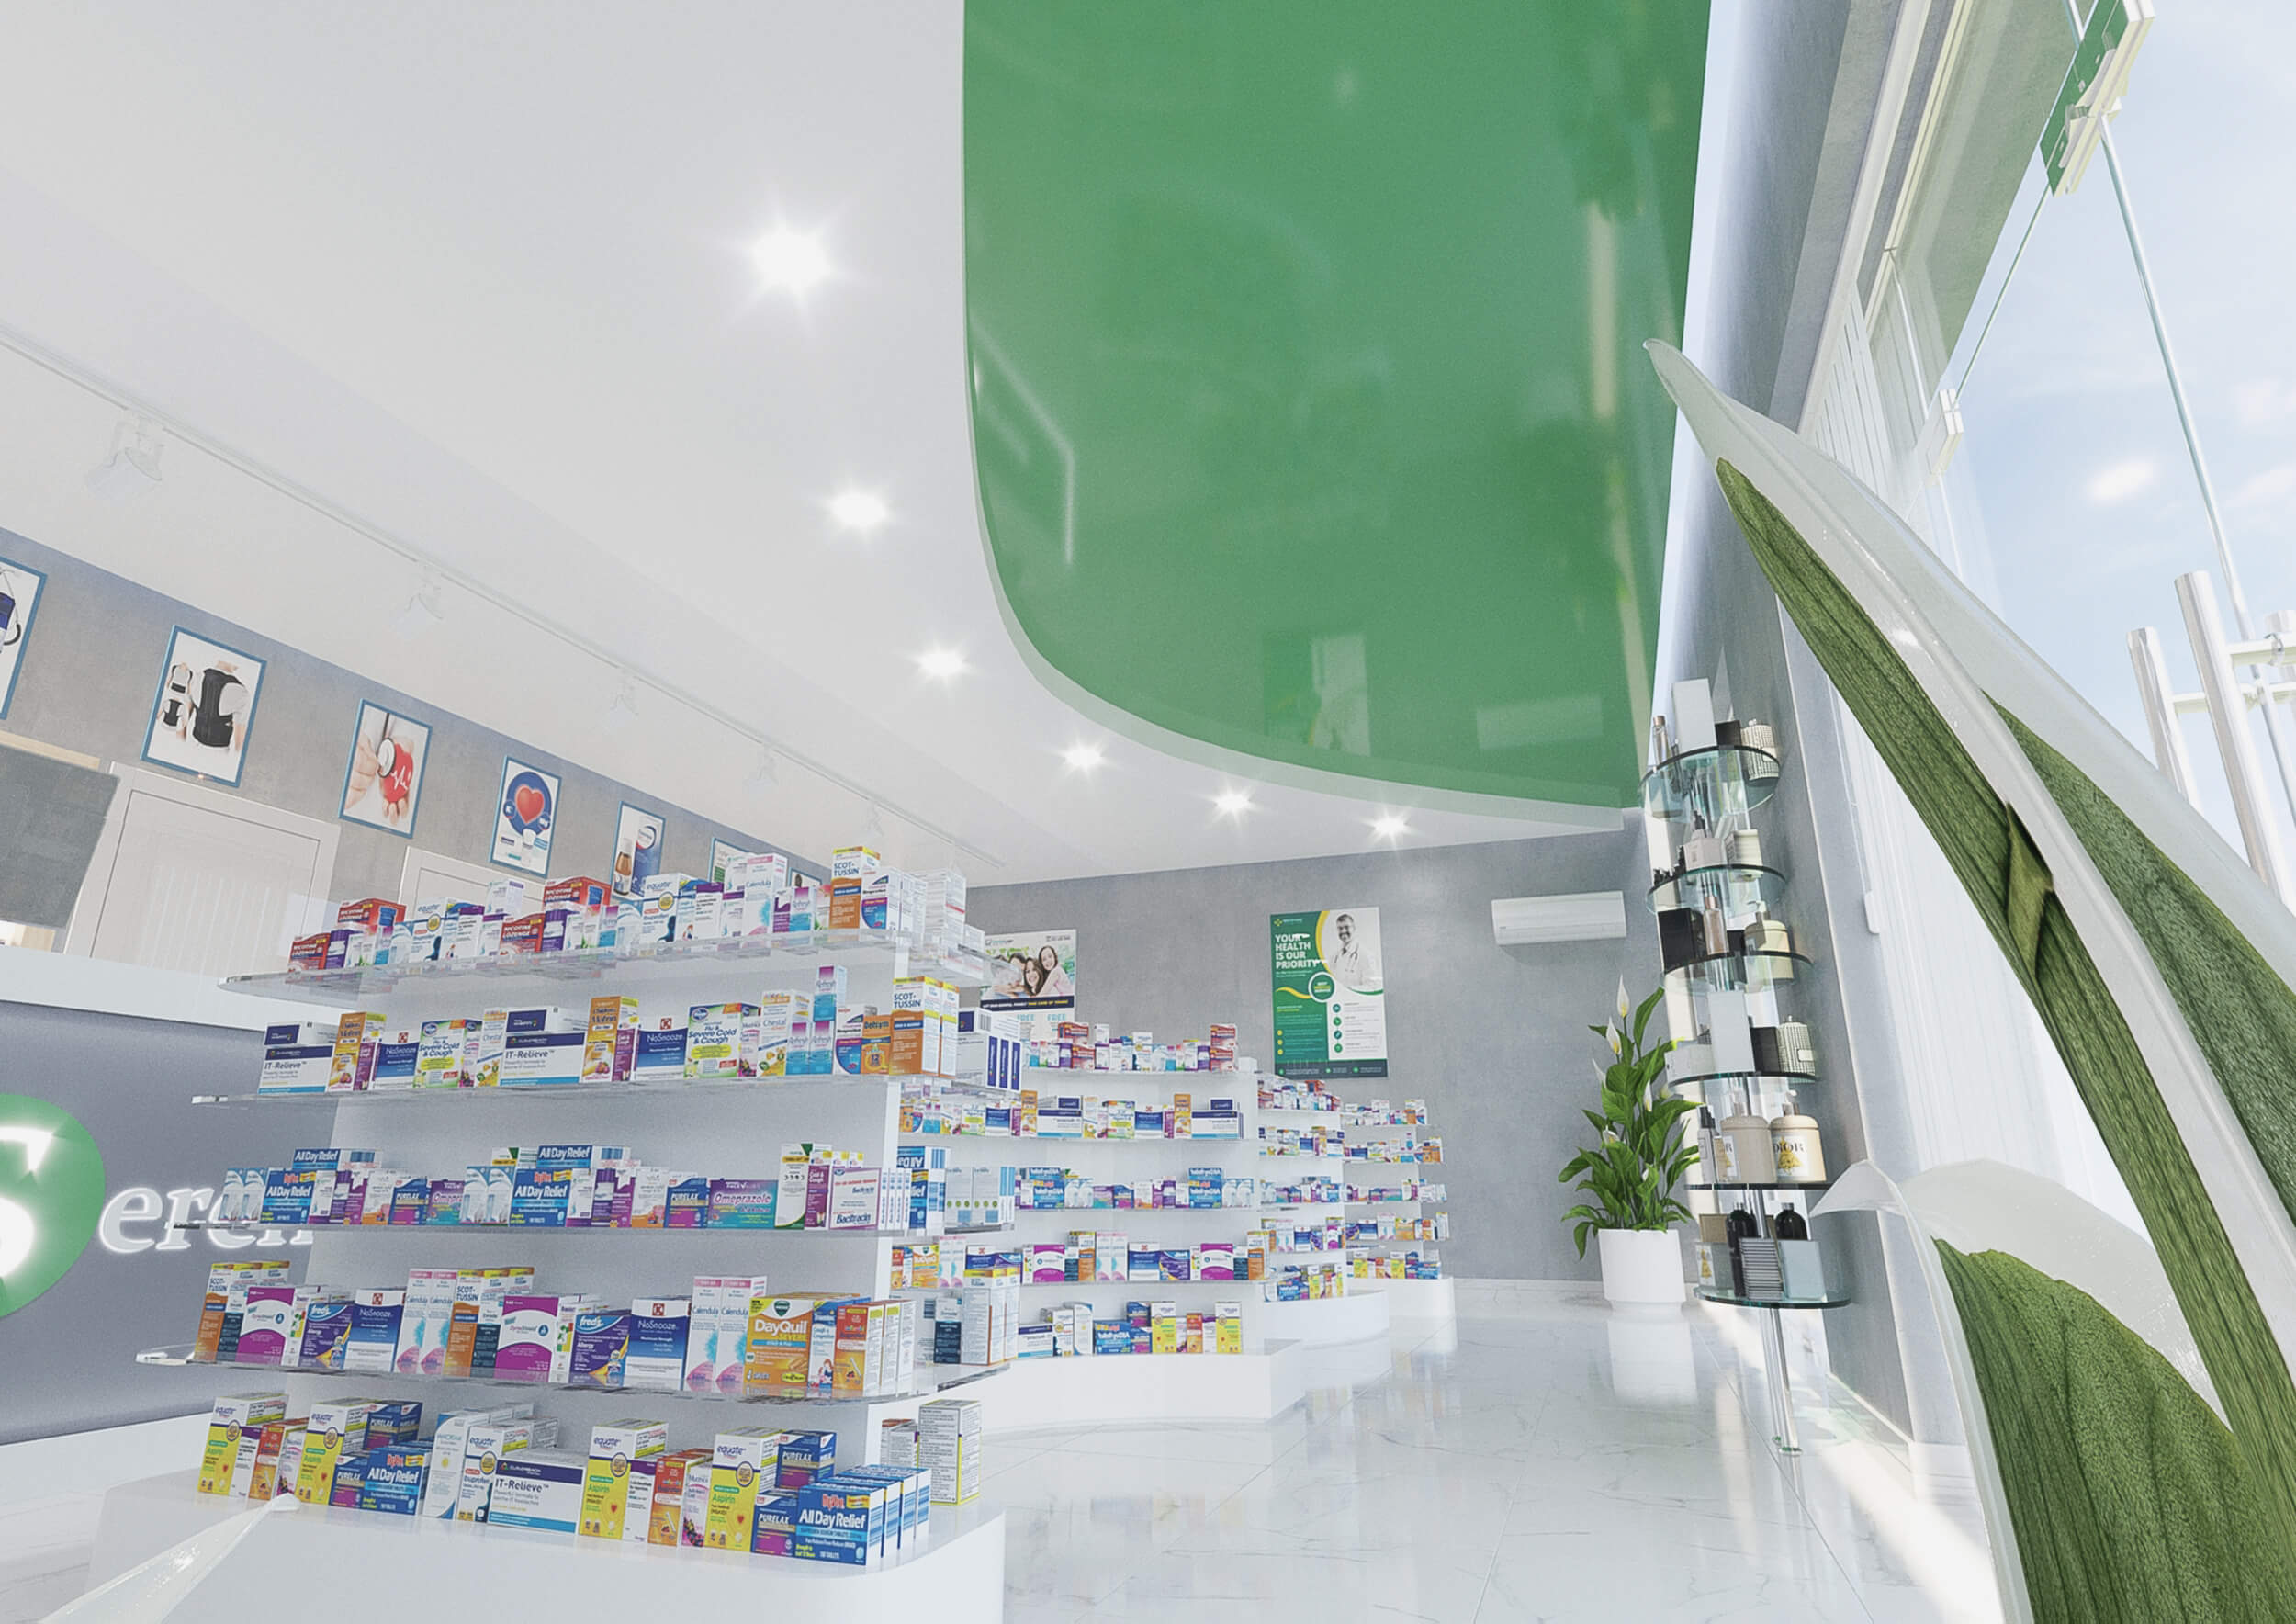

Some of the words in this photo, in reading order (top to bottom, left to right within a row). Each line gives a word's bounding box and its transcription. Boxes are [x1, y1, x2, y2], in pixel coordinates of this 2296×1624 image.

[1275, 934, 1301, 943] YOUR
[1275, 942, 1311, 952] HEALTH
[1276, 952, 1284, 960] IS
[1286, 951, 1306, 960] OUR
[1276, 959, 1318, 969] PRIORITY
[894, 1000, 921, 1009] TUSSIN
[318, 1150, 337, 1161] Relief
[540, 1147, 551, 1158] All
[551, 1147, 566, 1161] Day
[567, 1146, 590, 1159] Relief
[266, 1186, 277, 1197] All
[277, 1186, 290, 1199] Day
[290, 1186, 312, 1198] Relief
[515, 1186, 527, 1198] All
[527, 1186, 542, 1200] Day
[543, 1185, 568, 1199] Relief
[715, 1193, 771, 1205] Omeprazole
[837, 1213, 872, 1224] Bacitracin
[456, 1286, 476, 1294] SCOT-
[456, 1293, 478, 1302] TUSSIN
[692, 1306, 719, 1314] Calendula
[721, 1307, 748, 1315] Calendula
[638, 1320, 677, 1330] NoSnooze
[754, 1319, 808, 1336] DayQuil
[469, 1437, 496, 1449] equate
[594, 1437, 622, 1449] equate
[717, 1445, 747, 1459] equate
[782, 1450, 813, 1462] PURELAX
[367, 1467, 381, 1481] All
[381, 1468, 397, 1484] Day
[396, 1469, 419, 1483] Relief
[713, 1494, 736, 1506] Aspirin
[759, 1513, 789, 1525] PURELAX
[799, 1509, 815, 1524] All
[815, 1510, 836, 1529] Day
[836, 1512, 866, 1529] Relief
